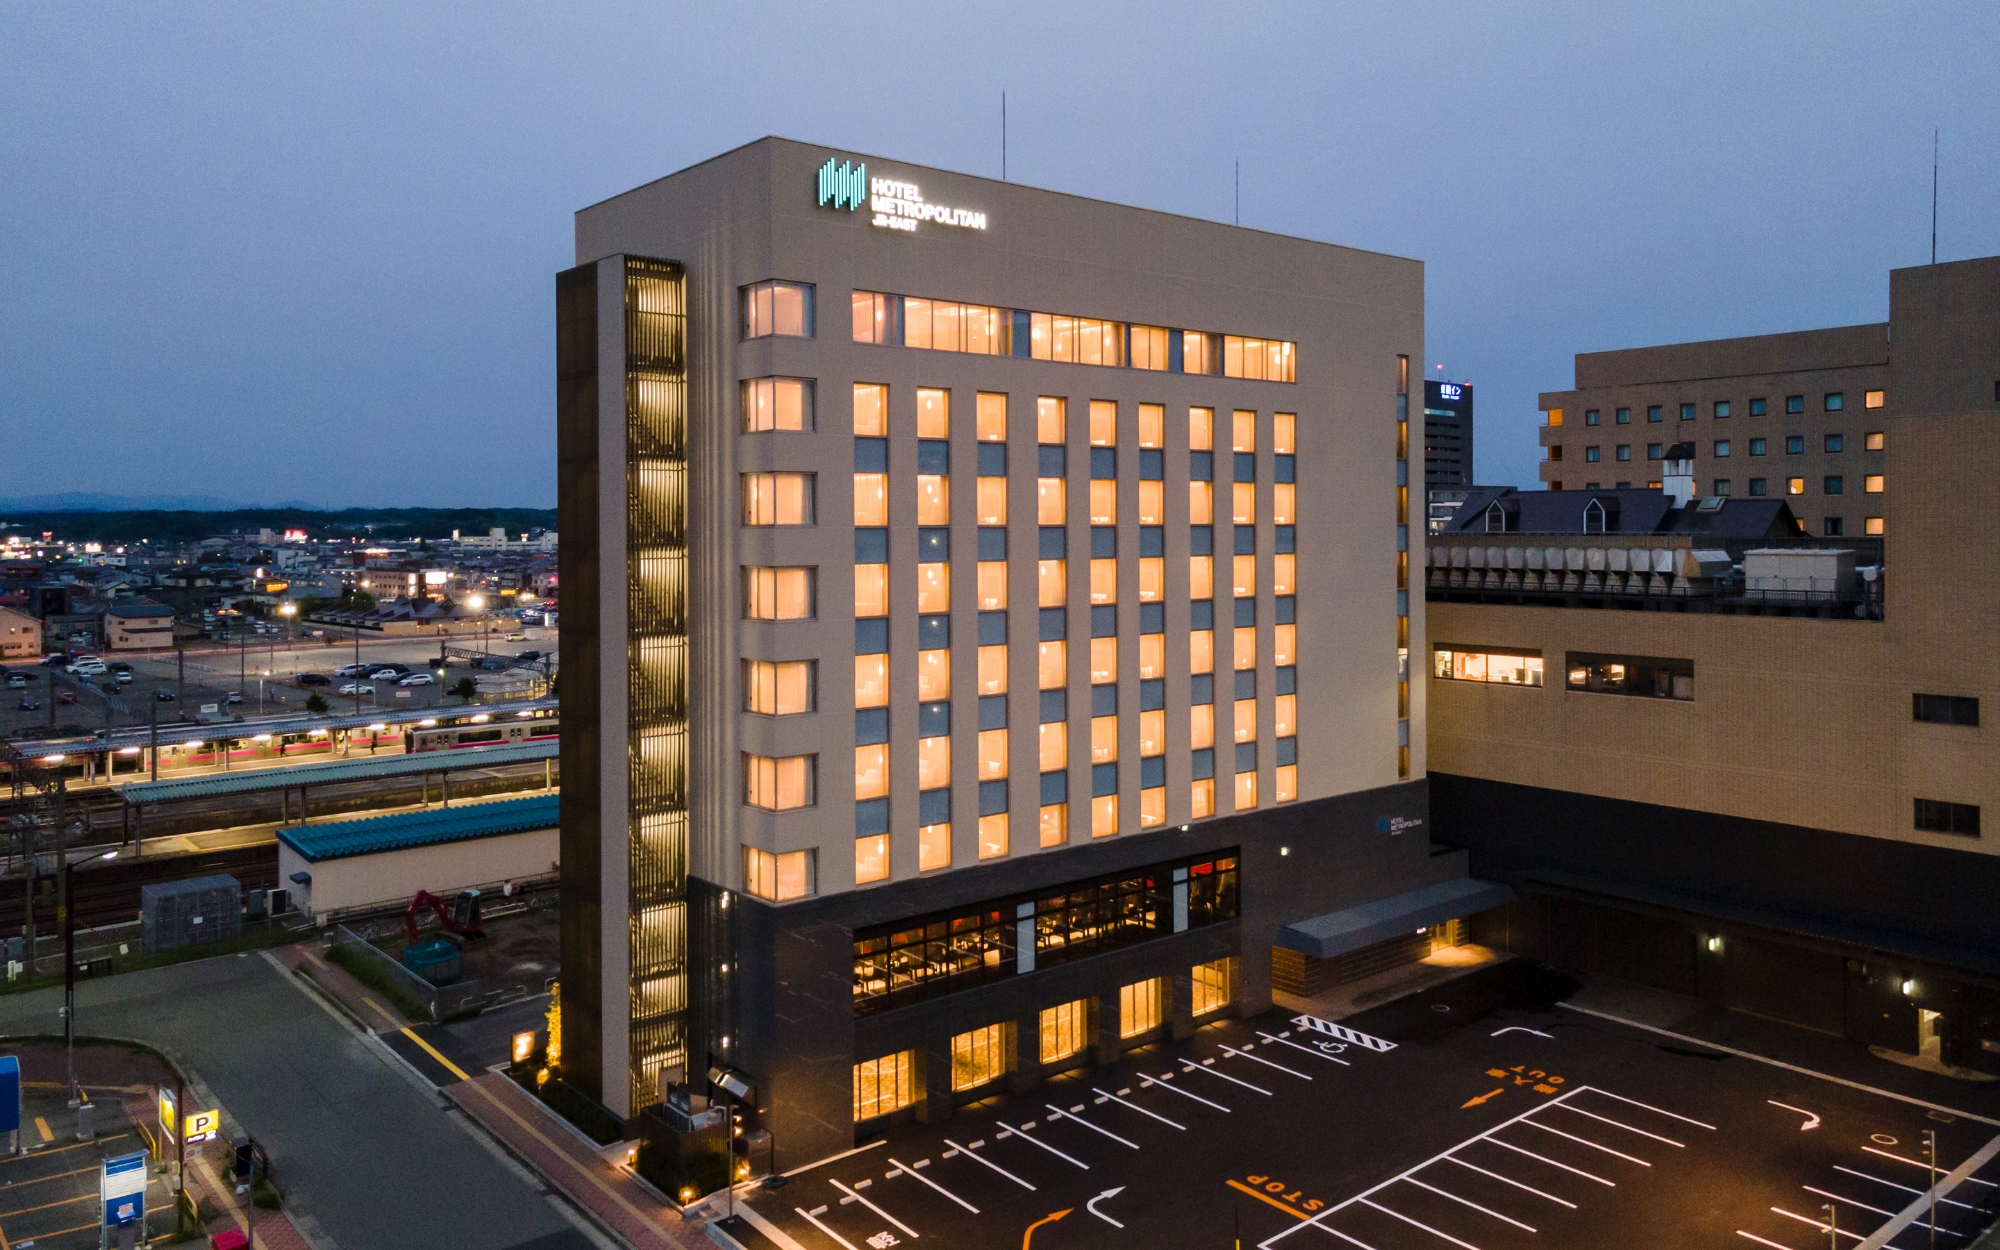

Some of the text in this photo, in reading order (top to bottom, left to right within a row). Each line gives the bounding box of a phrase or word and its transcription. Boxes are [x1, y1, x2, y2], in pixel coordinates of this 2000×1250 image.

[872, 177, 923, 202] HOTEL
[871, 194, 987, 230] METROPOLITAN
[1509, 1065, 1565, 1084] OUT
[196, 1117, 209, 1131] P
[1246, 1175, 1324, 1211] STOP
